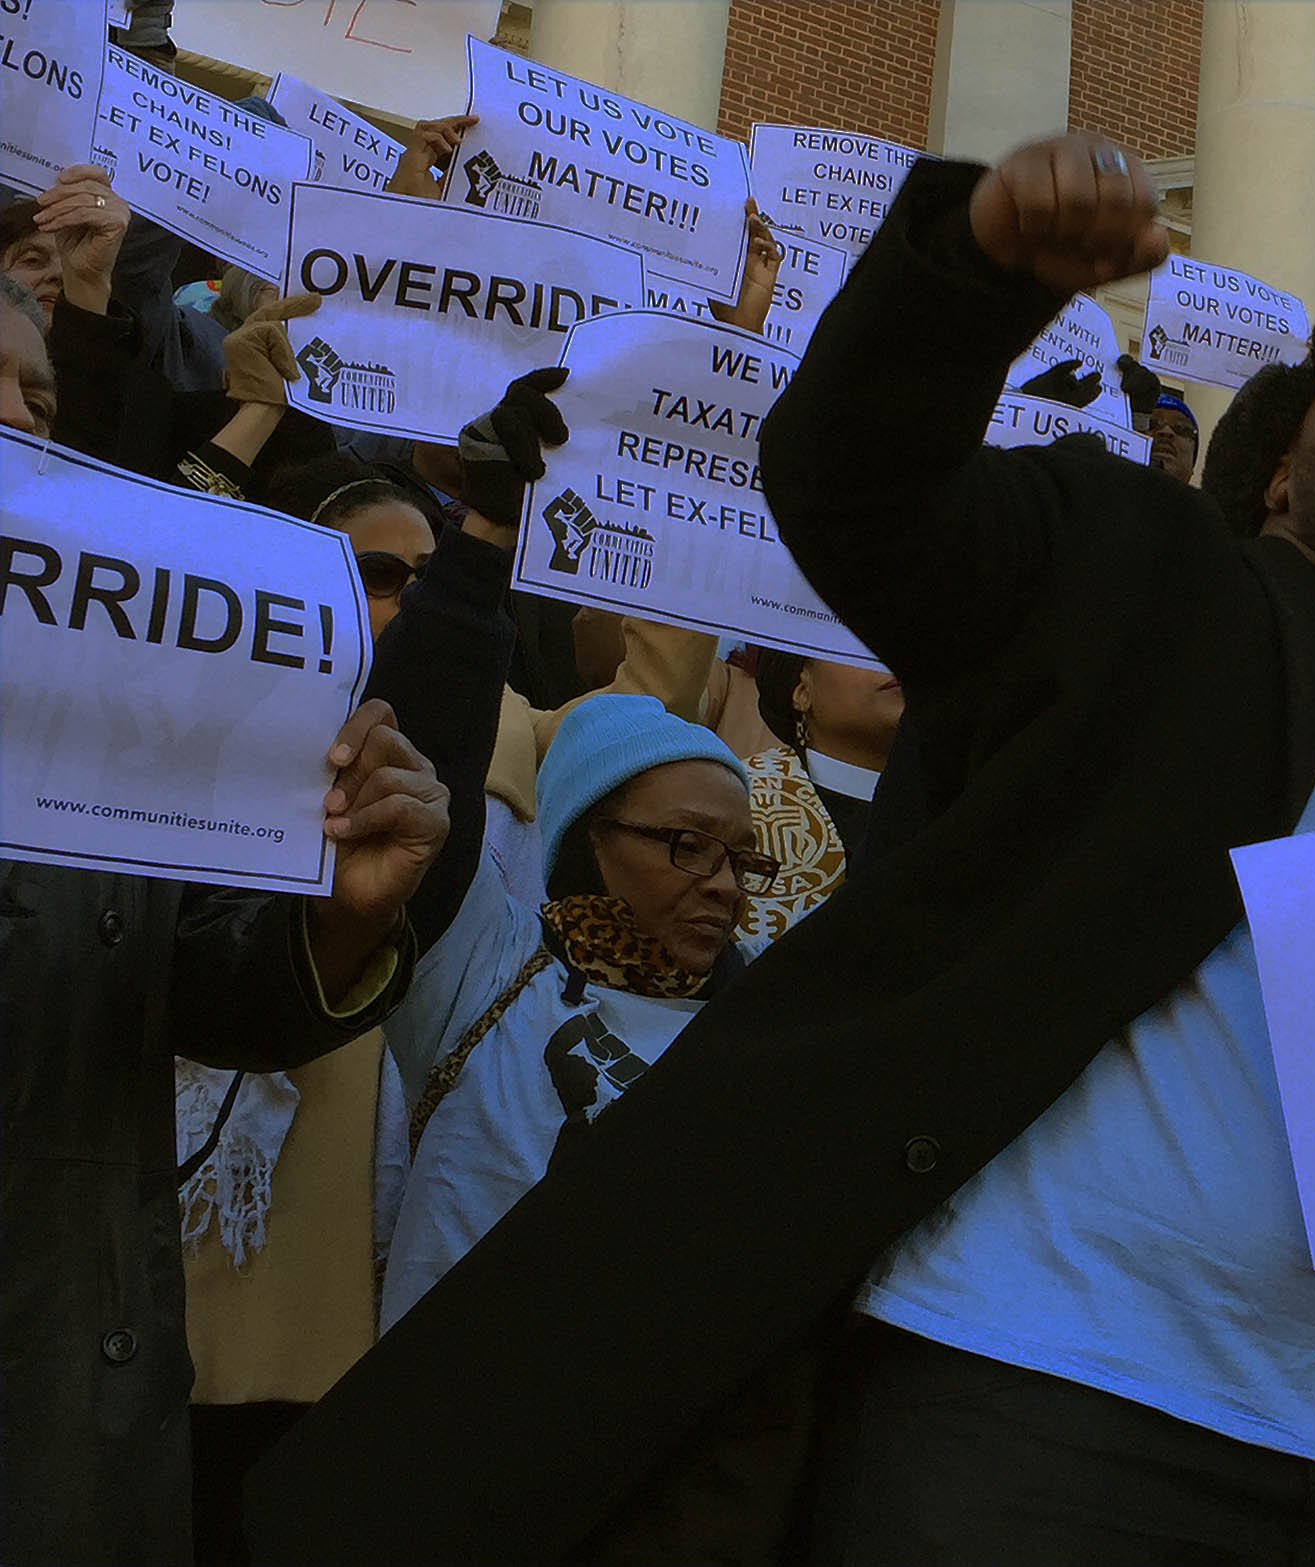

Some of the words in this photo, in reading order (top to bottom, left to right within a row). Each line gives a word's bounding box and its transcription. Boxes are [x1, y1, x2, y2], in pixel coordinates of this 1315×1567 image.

[0, 38, 84, 99] LONS
[108, 50, 210, 115] REMOVE
[219, 105, 266, 139] THE
[132, 91, 232, 151] CHAINS!
[309, 103, 351, 136] LET
[354, 128, 382, 155] EX
[506, 60, 568, 99] LET
[579, 88, 624, 121] US
[630, 108, 718, 159] VOTE
[149, 126, 181, 156] EX
[189, 146, 282, 205] FELONS
[518, 101, 592, 148] OUR
[602, 130, 711, 188] VOTES
[793, 132, 879, 161] REMOVE
[886, 147, 916, 169] THE
[137, 151, 211, 204] VOTE!
[528, 151, 700, 233] MATTER!!!
[782, 187, 821, 207] LET
[827, 193, 854, 213] EX
[814, 163, 894, 192] CHAINS!
[301, 248, 632, 334] OVERRID
[1171, 260, 1207, 283] LET
[1213, 271, 1240, 292] US
[1245, 280, 1294, 312] VOTE
[1068, 320, 1101, 349] WITH
[1177, 290, 1220, 317] OUR
[1225, 302, 1290, 335] VOTES
[711, 345, 762, 384] WE
[1182, 322, 1281, 363] MATTER!!!
[341, 381, 396, 414] UNITED
[1033, 410, 1070, 440] US
[596, 474, 656, 512] LET
[667, 492, 777, 543] EX-FEL
[589, 546, 652, 590] UNITED
[0, 535, 335, 676] RRIDE!
[36, 795, 285, 844] www.communitiesunite.org
